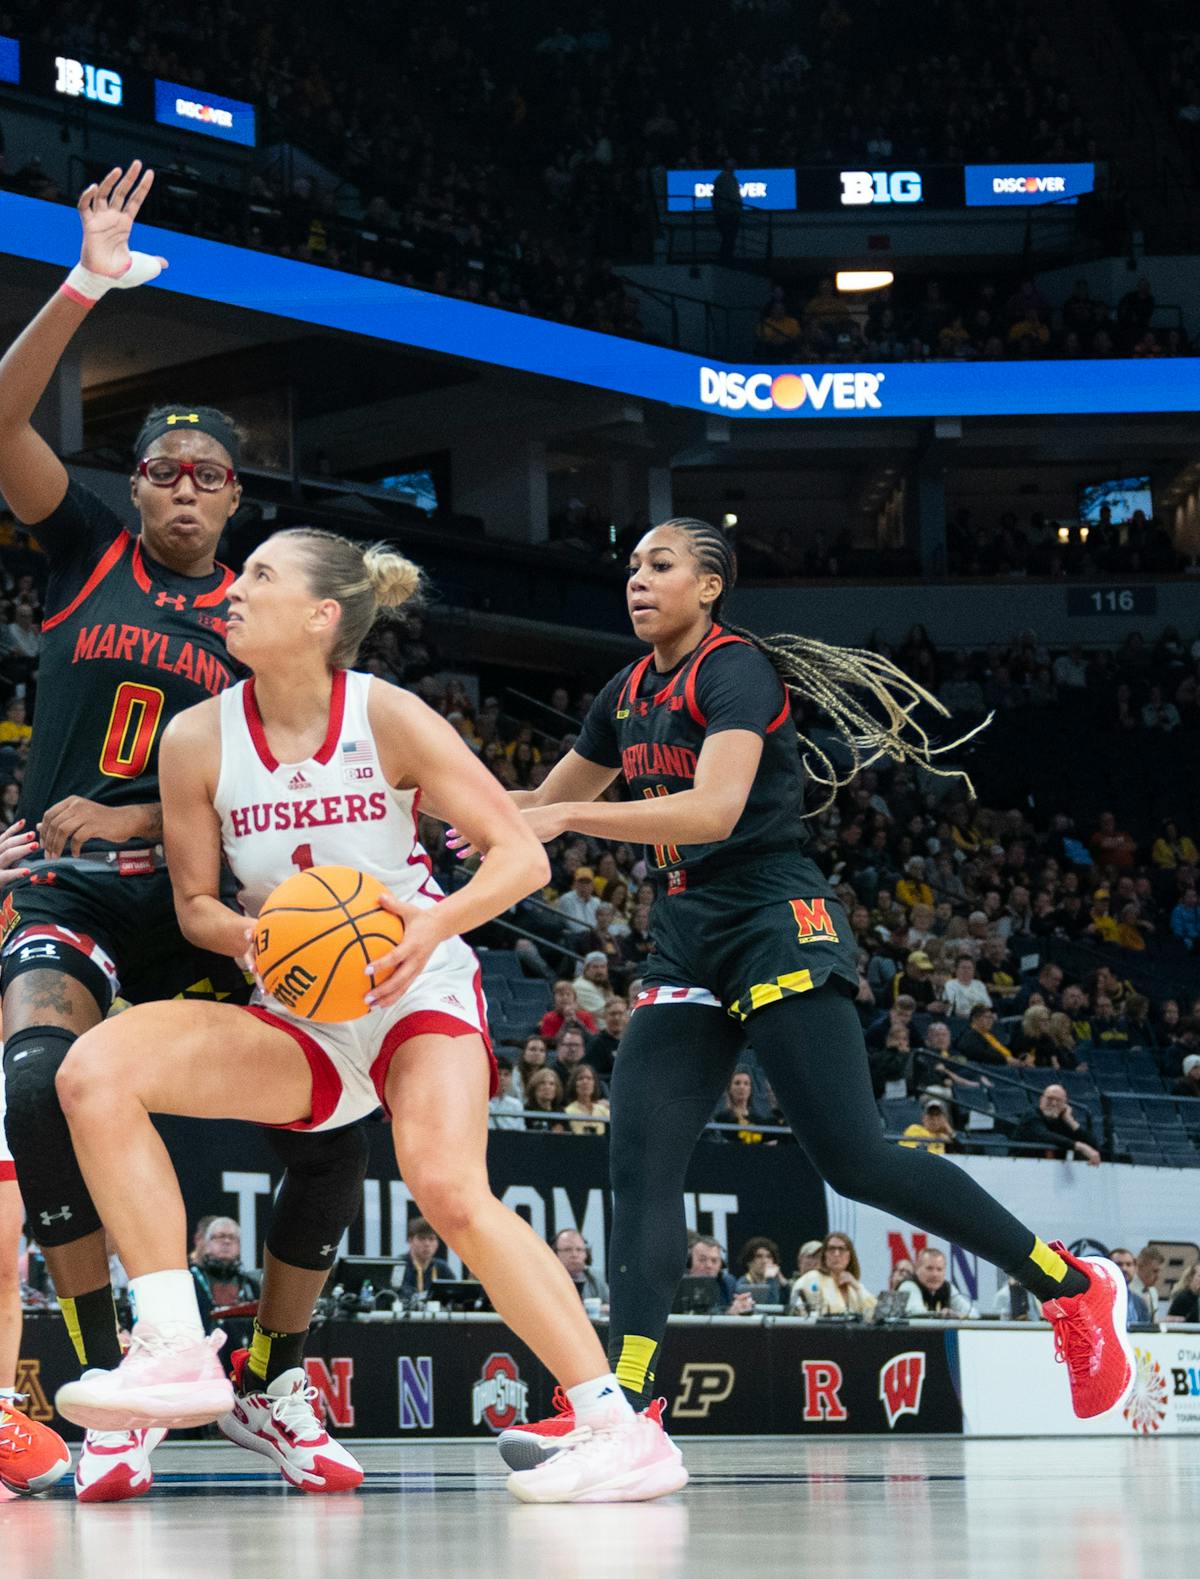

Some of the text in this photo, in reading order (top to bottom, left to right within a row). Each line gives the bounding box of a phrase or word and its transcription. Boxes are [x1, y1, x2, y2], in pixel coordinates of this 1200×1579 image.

[992, 177, 1065, 193] DISCOVER
[700, 366, 884, 411] DISCOVER
[1090, 590, 1134, 611] 116
[72, 623, 231, 695] MARYLAND
[99, 681, 164, 779] 0
[230, 792, 387, 838] HUSKERS
[789, 898, 837, 937] M
[303, 1356, 354, 1428] N
[398, 1356, 434, 1429] N
[672, 1363, 735, 1418] P
[801, 1360, 848, 1421] R
[880, 1351, 926, 1429] W
